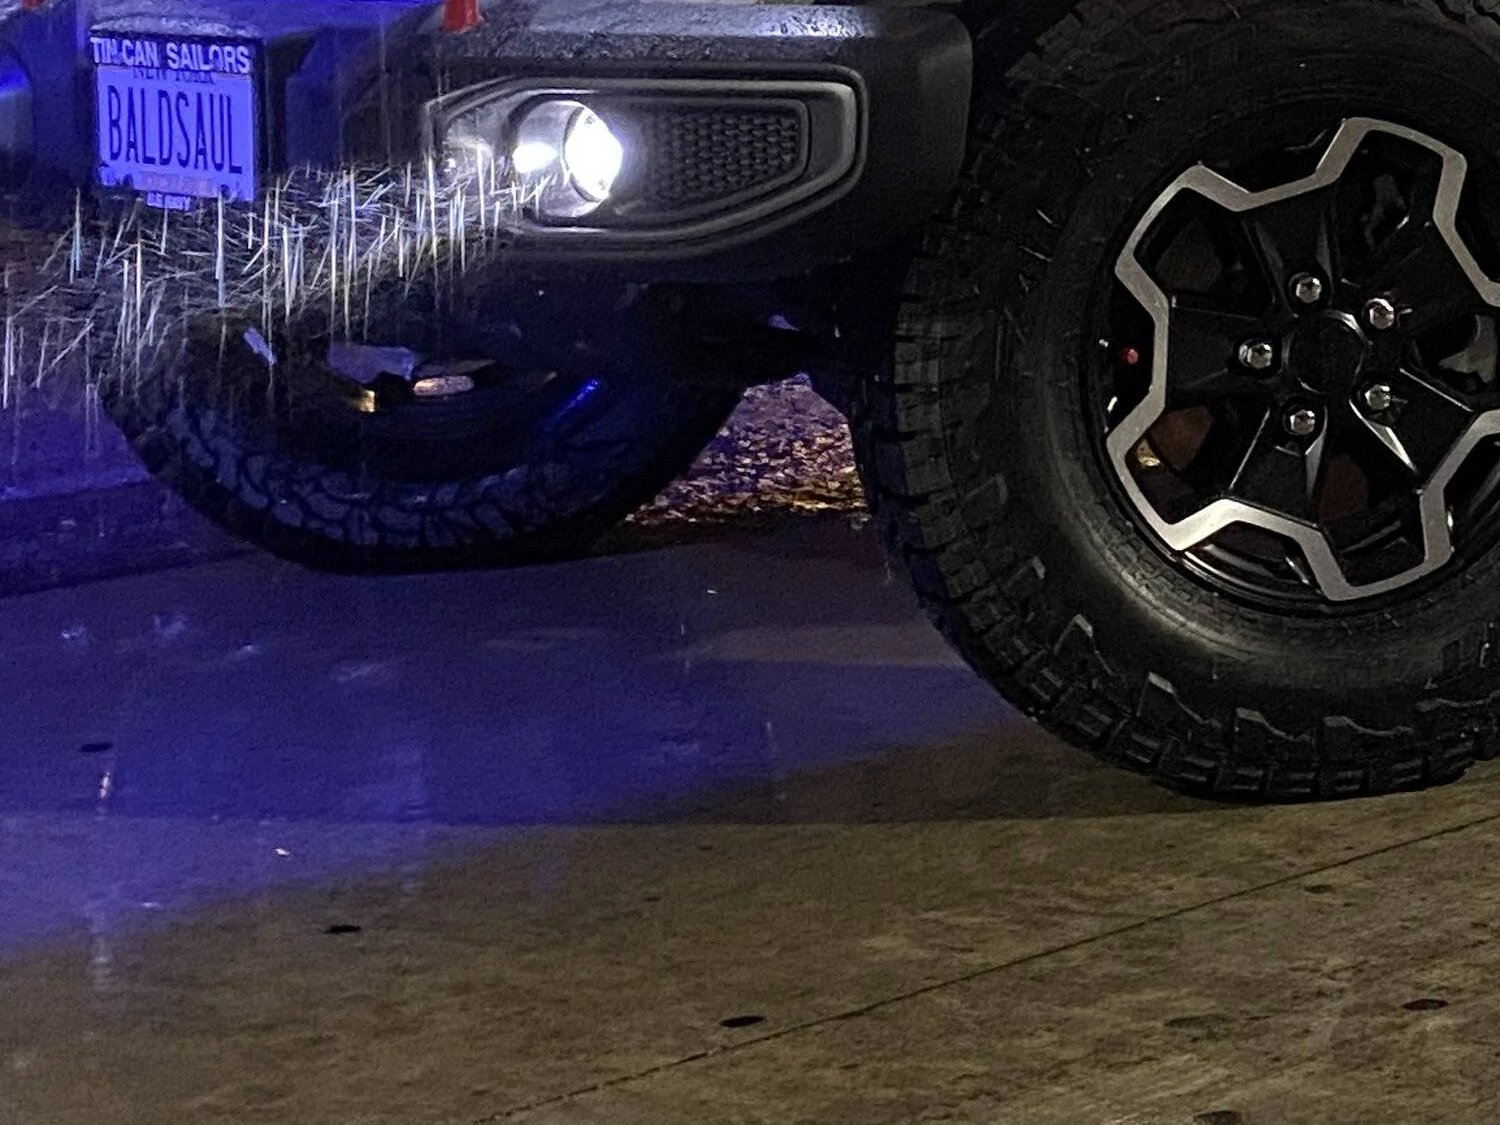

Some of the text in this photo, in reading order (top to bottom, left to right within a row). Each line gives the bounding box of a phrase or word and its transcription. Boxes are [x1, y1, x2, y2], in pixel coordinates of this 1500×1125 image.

[122, 40, 159, 68] CAN
[166, 43, 248, 74] SAILORS
[107, 85, 242, 174] BALDSAUL
